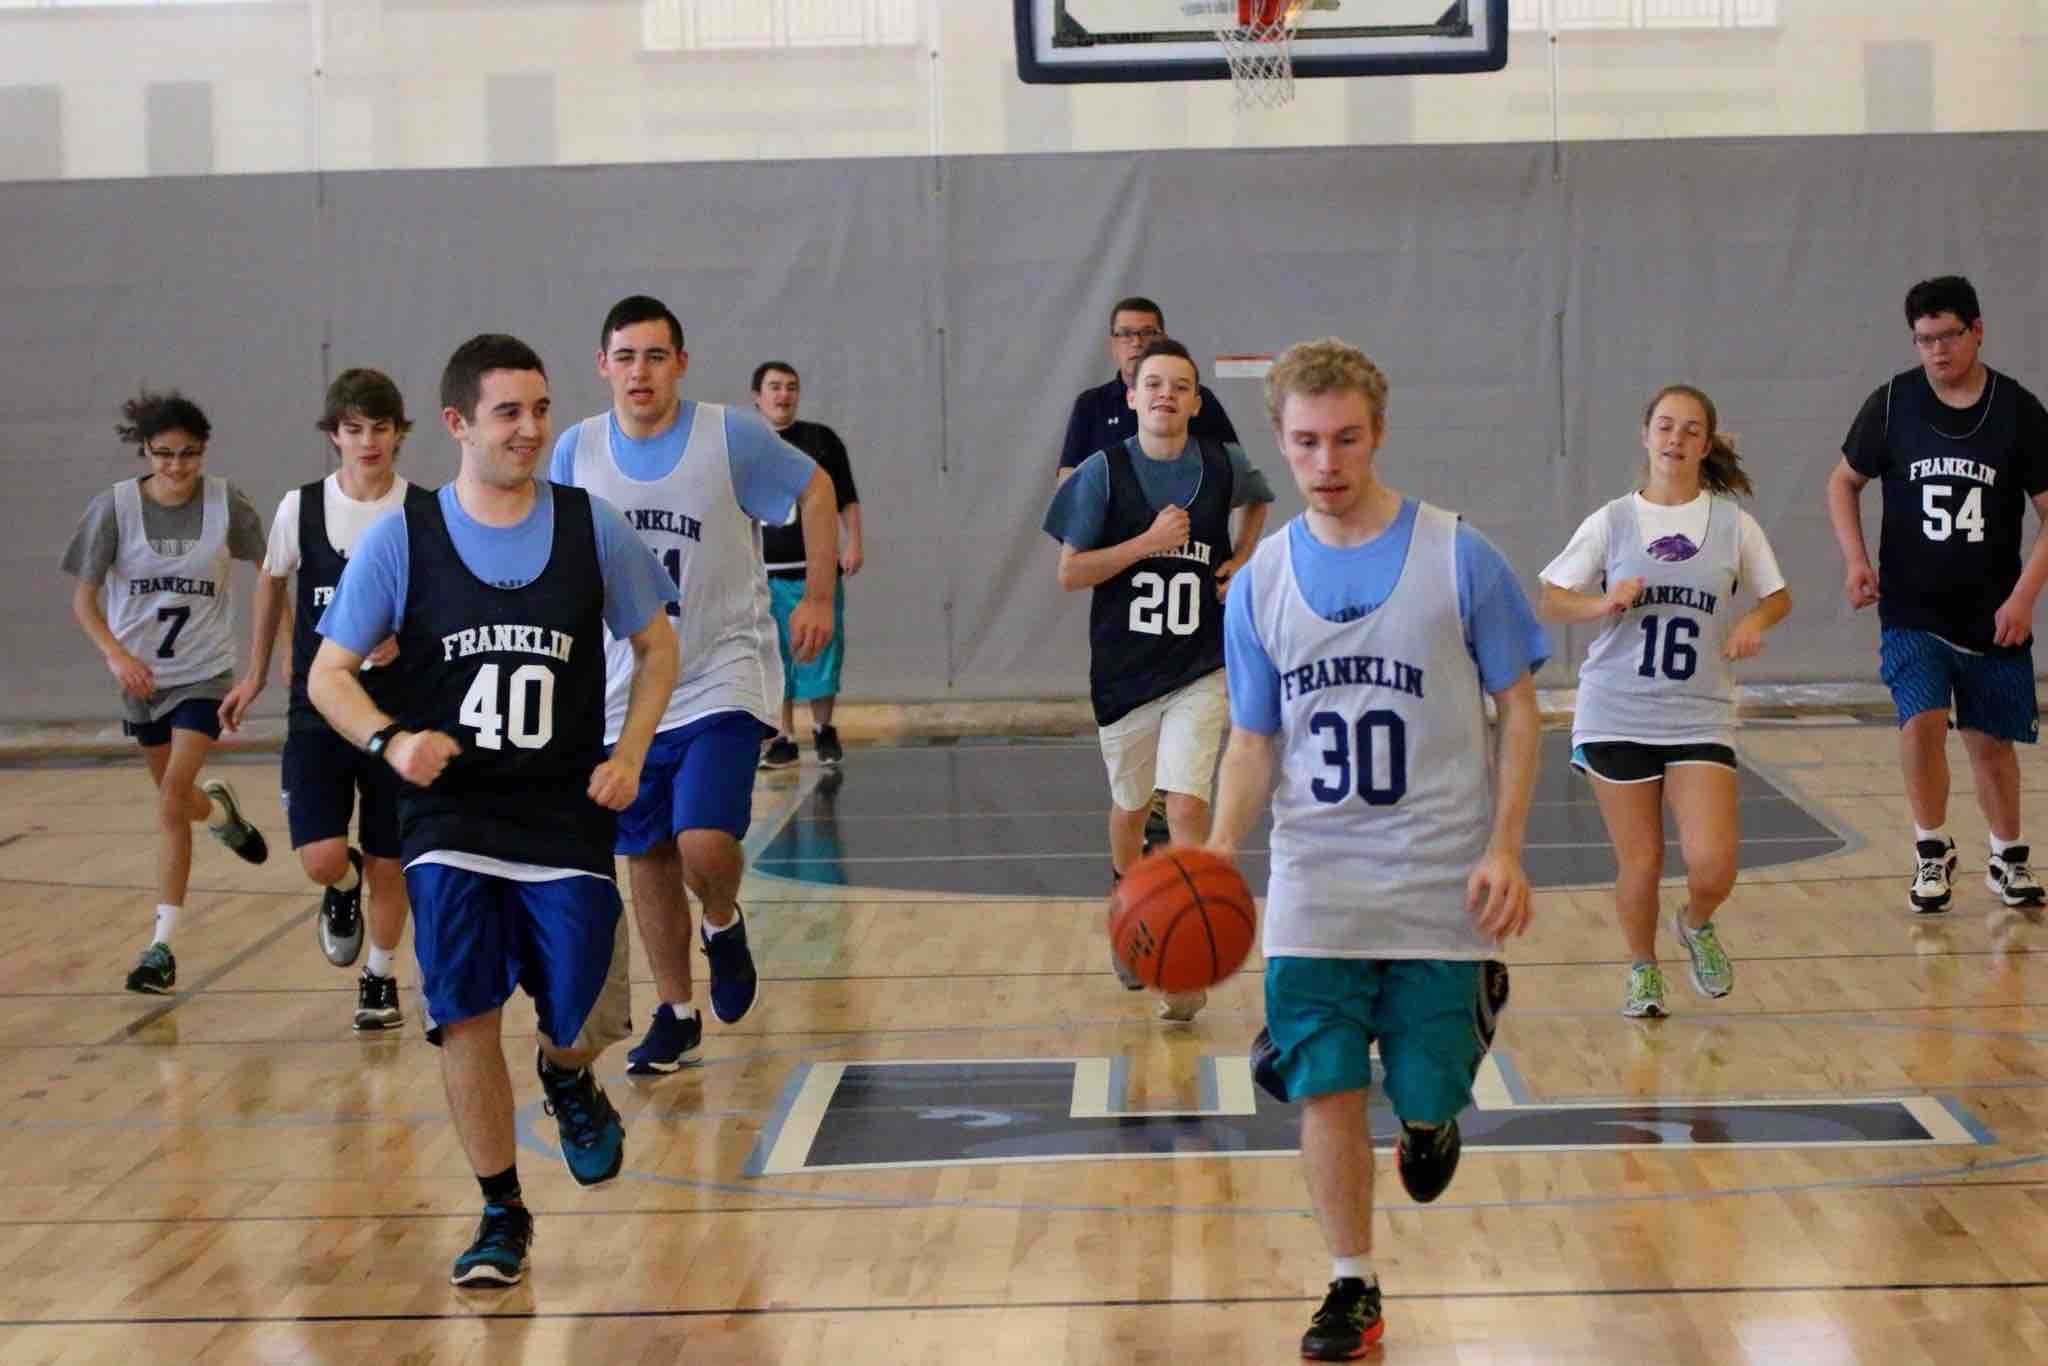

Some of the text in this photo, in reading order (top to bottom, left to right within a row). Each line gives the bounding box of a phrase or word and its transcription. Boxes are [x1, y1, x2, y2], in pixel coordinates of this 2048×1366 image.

[1909, 456, 1997, 487] FRANKLIN
[624, 509, 703, 542] NKLIN
[1922, 484, 1985, 543] 54
[129, 576, 216, 597] FRANKLIN
[1129, 571, 1201, 635] 20
[1631, 584, 1717, 615] ANKLIN
[156, 605, 191, 658] 7
[441, 624, 574, 663] FRANKLIN
[1638, 614, 1700, 680] 16
[1282, 655, 1424, 701] FRANKLIN
[458, 663, 555, 750] 40
[1310, 709, 1407, 806] 30
